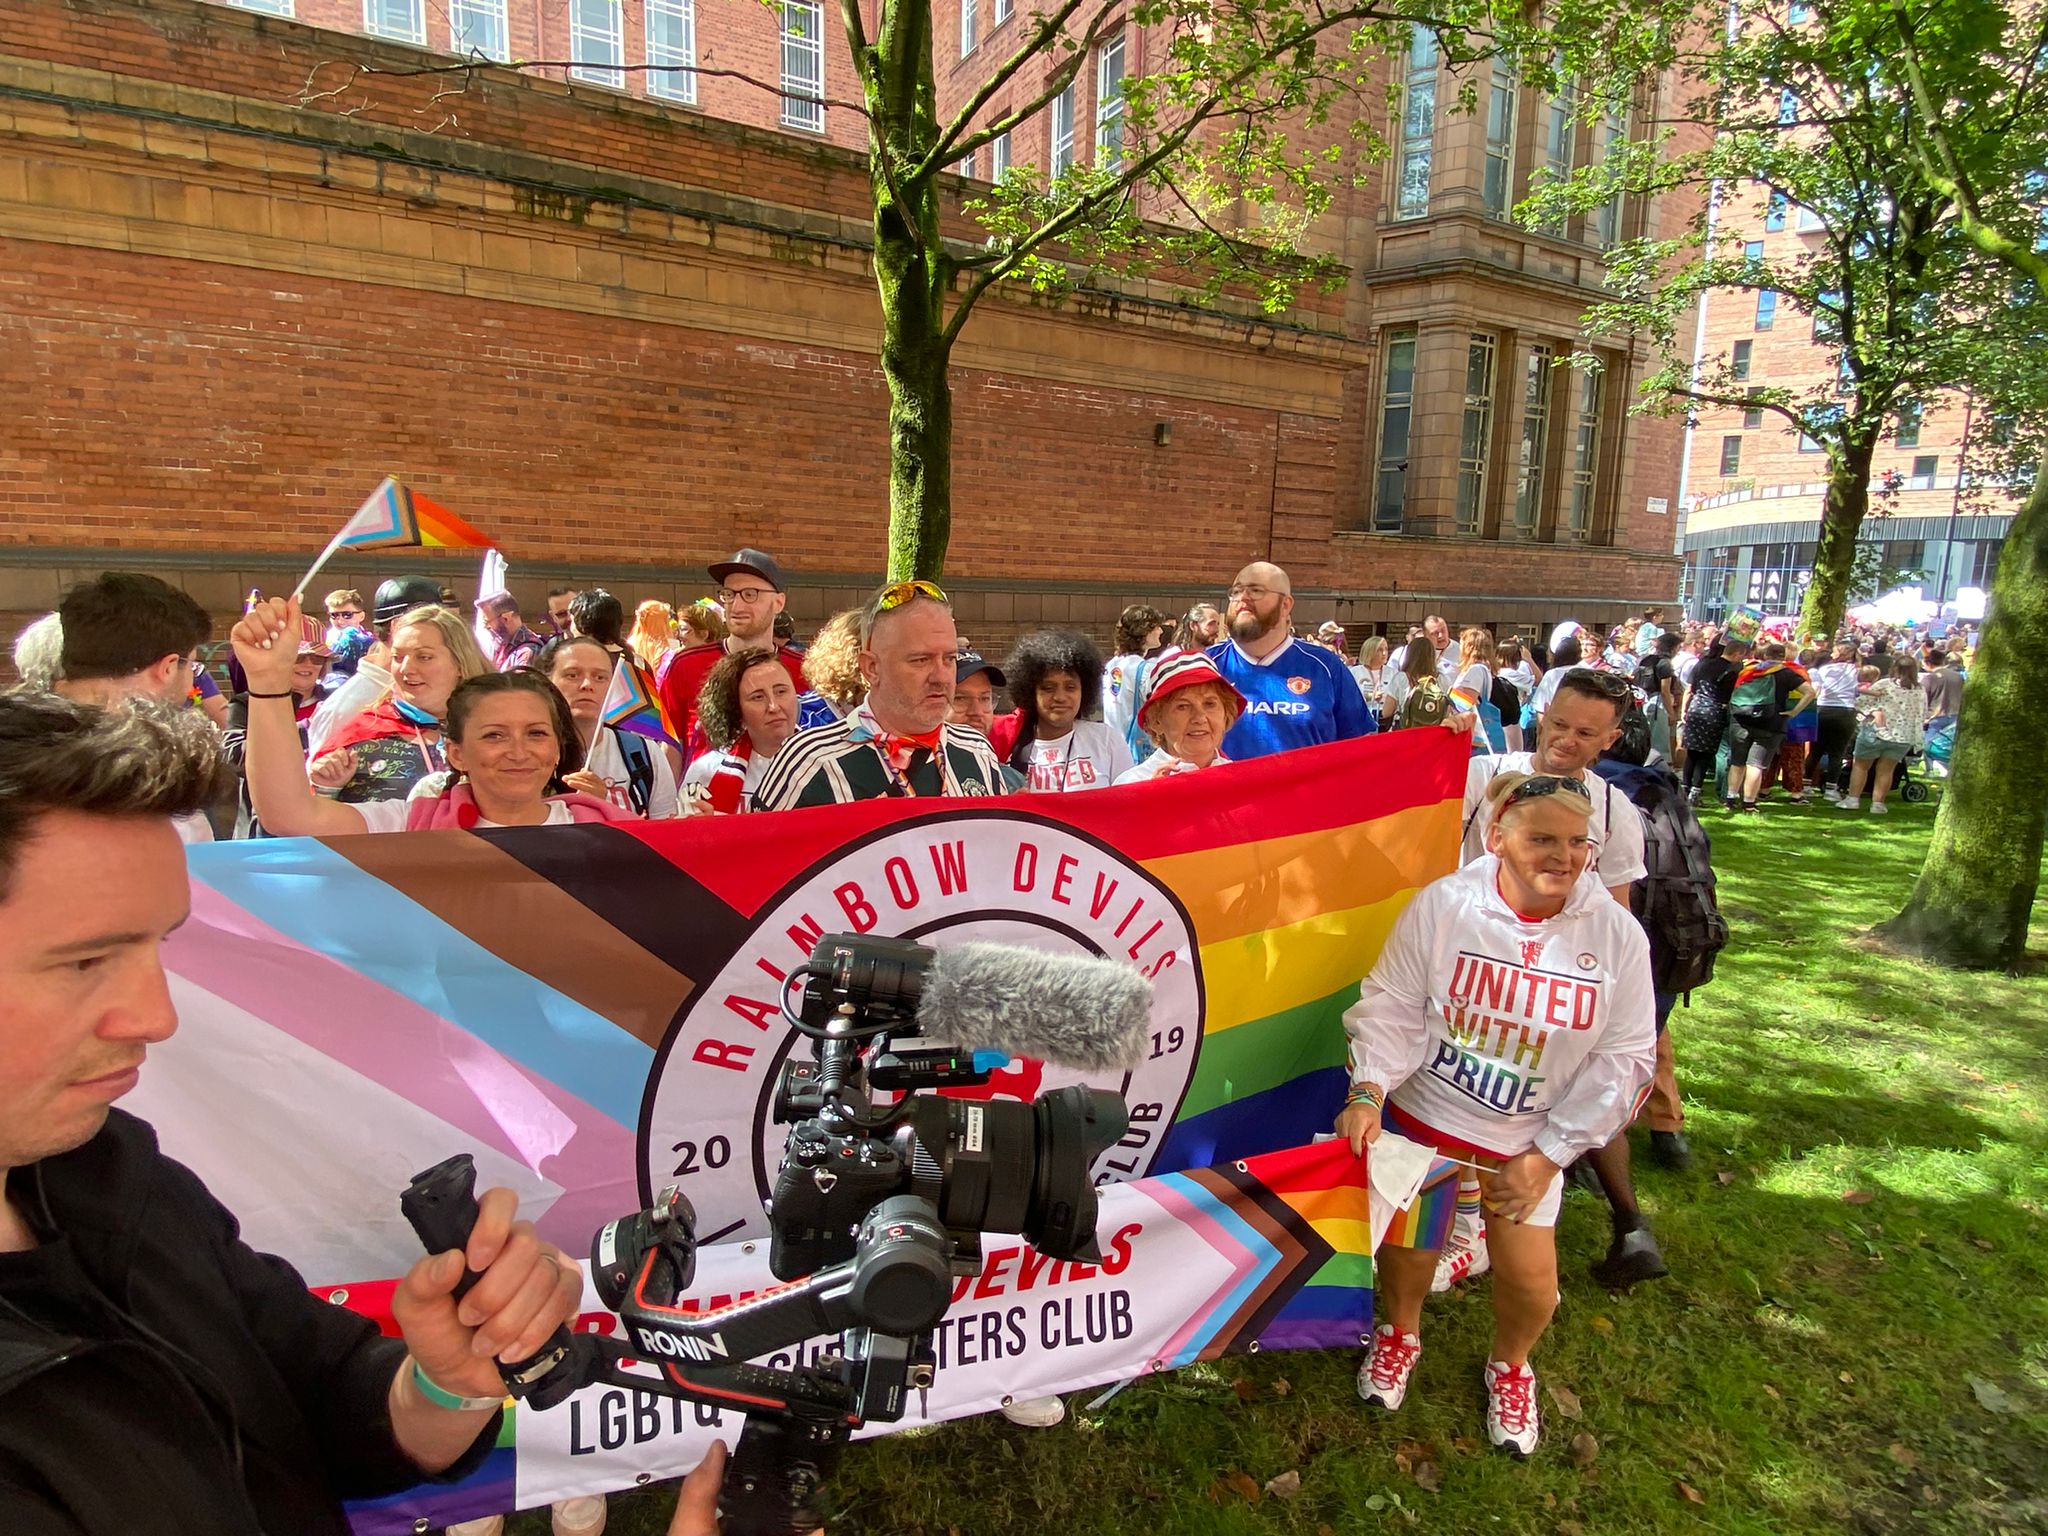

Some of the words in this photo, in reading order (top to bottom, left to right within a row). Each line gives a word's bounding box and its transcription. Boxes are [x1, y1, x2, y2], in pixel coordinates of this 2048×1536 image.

[1245, 701, 1310, 715] HARP
[1027, 759, 1097, 790] NITED
[692, 840, 968, 1072] RAINBOW
[1013, 842, 1176, 981] DEVILS
[1448, 956, 1598, 1031] UNITED
[1148, 1026, 1184, 1061] 19
[1443, 1005, 1549, 1071] WITH
[1430, 1038, 1547, 1113] PRIDE
[672, 1135, 731, 1177] 20
[637, 1327, 730, 1362] RONIN
[1040, 1289, 1134, 1351] CLUB
